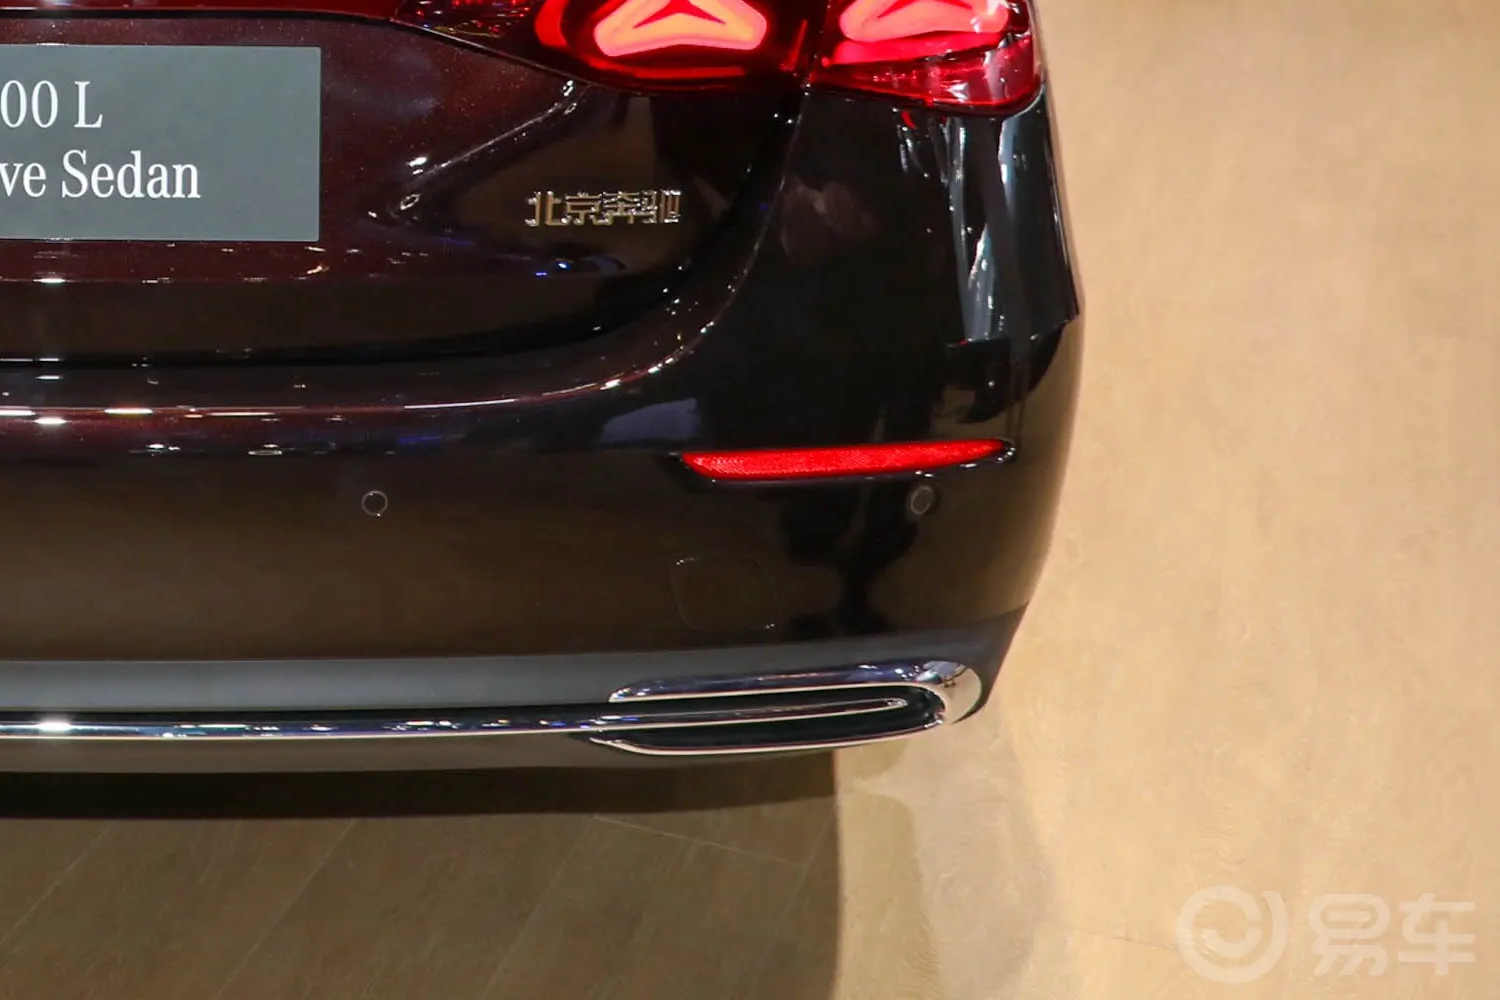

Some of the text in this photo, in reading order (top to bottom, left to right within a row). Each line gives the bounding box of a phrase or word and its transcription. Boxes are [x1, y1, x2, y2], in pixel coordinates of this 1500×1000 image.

[74, 81, 104, 128] L
[61, 149, 201, 199] Sedan
[525, 189, 682, 227] 北京奔驰
